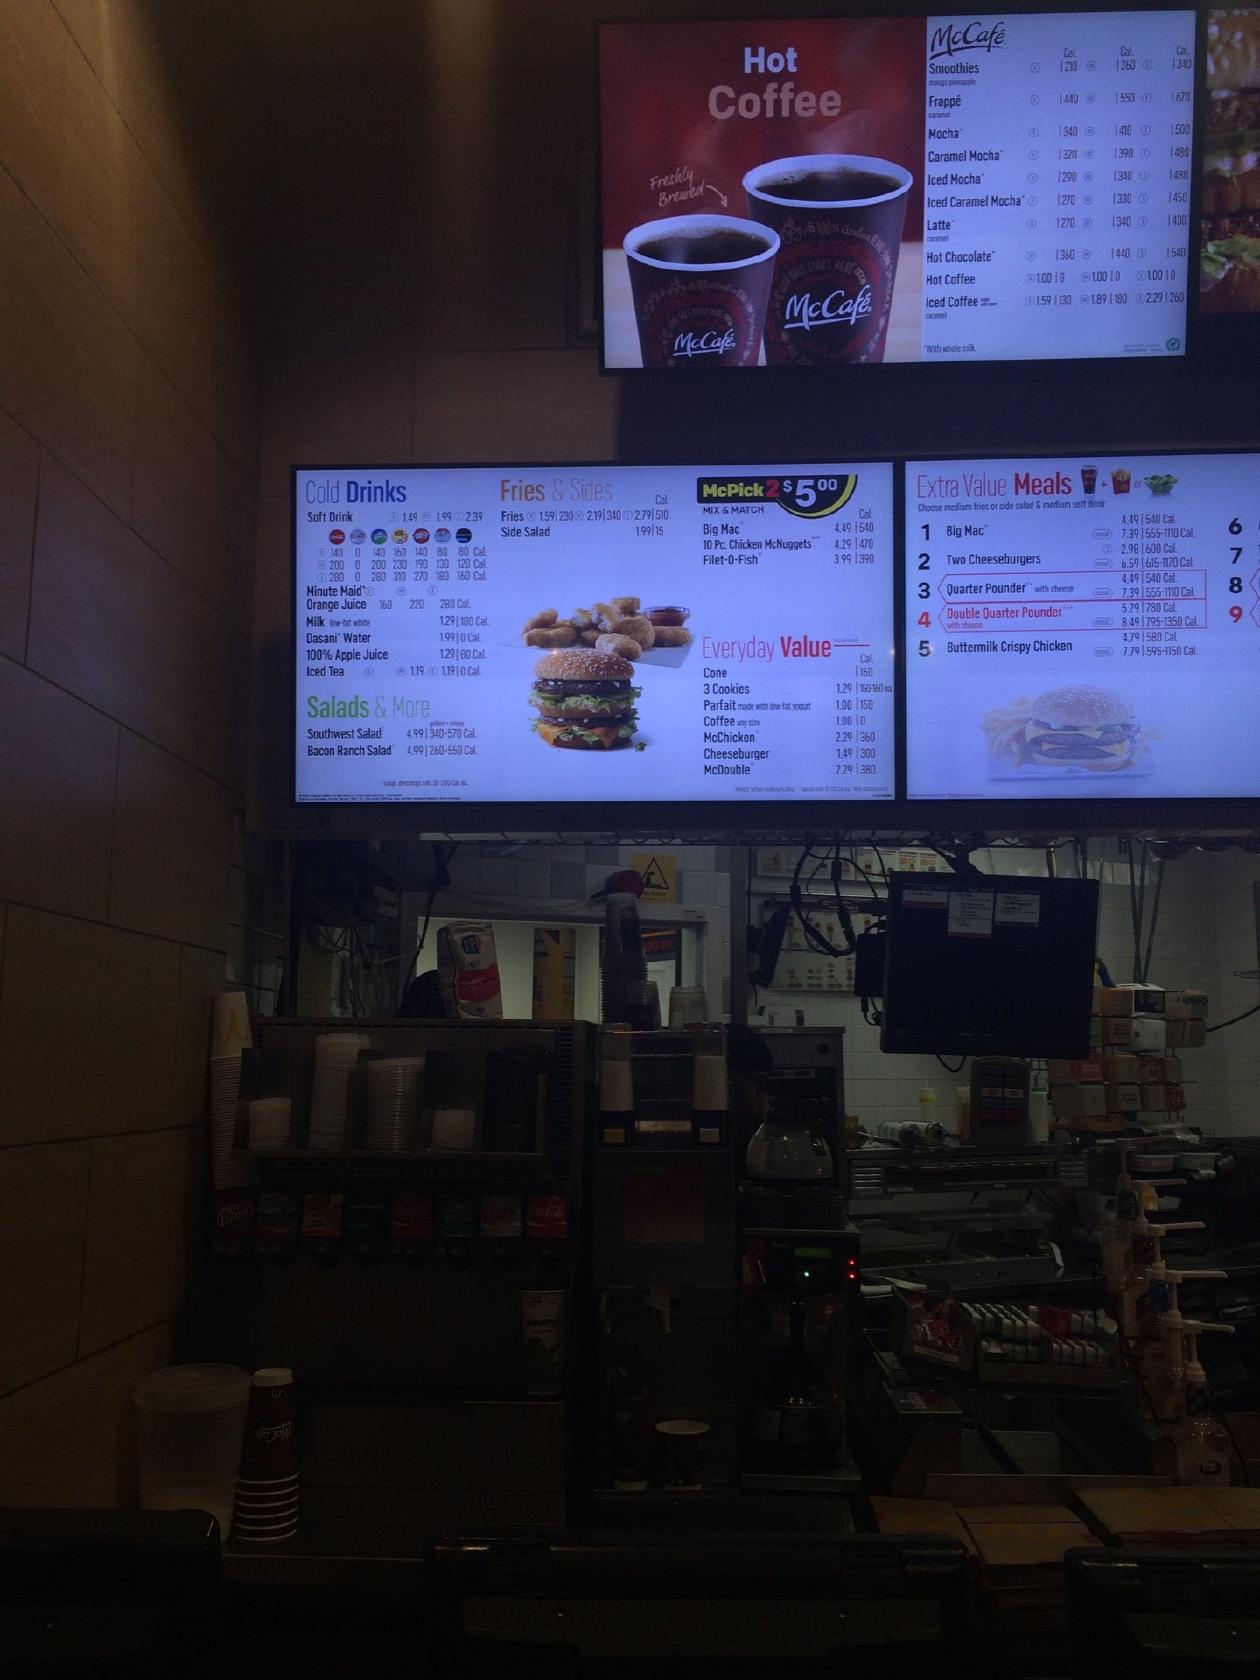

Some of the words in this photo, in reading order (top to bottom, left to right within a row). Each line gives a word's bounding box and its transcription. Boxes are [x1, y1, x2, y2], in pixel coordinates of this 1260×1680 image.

[929, 21, 1005, 60] McCafé
[744, 47, 797, 73] Hot
[929, 62, 979, 75] Smoothies
[709, 82, 842, 120] Coffee
[929, 94, 961, 108] Frappé
[928, 151, 967, 163] Caramel
[650, 167, 693, 191] Freshly
[928, 174, 948, 186] Iced
[658, 180, 705, 206] Brewed
[928, 196, 948, 208] Iced
[950, 195, 989, 207] Caramel
[927, 252, 943, 263] Hot
[927, 274, 942, 285] Hot
[944, 274, 976, 284] Coffee
[784, 284, 872, 330] McCafé
[926, 297, 946, 308] Iced
[948, 296, 978, 307] Coffee
[673, 329, 736, 356] McCafé
[501, 480, 545, 501] Fries
[571, 479, 612, 500] Sides
[703, 483, 764, 497] McPick
[766, 480, 779, 497] 2
[918, 474, 958, 498] Extra
[964, 473, 1006, 496] Value
[1015, 472, 1072, 496] Meals
[306, 480, 340, 503] Cold
[347, 480, 406, 503] Drinks
[918, 504, 942, 512] Choose
[945, 503, 971, 511] medium
[974, 503, 989, 511] fries
[1000, 502, 1013, 510] side
[1015, 502, 1033, 510] salad
[1043, 501, 1071, 509] medium
[308, 512, 326, 522] Soft
[329, 512, 352, 522] Drink
[403, 513, 418, 521] 1.49
[437, 513, 452, 521] 1.99
[466, 512, 483, 521] 2.39
[501, 512, 524, 521] Fries
[1122, 515, 1138, 524] 4.49
[501, 527, 521, 537] Side
[525, 527, 550, 537] Salad
[703, 524, 718, 535] Big
[721, 524, 740, 534] Mac
[835, 523, 851, 532] 4.49
[922, 524, 930, 540] 1
[947, 526, 961, 538] Big
[965, 525, 984, 536] Mac
[1229, 518, 1242, 535] 6
[1122, 529, 1138, 539] 7.39
[1146, 528, 1179, 538] 555-1110
[703, 541, 712, 549] 10
[715, 540, 727, 549] Pc.
[729, 540, 762, 549] Chicken
[765, 539, 812, 550] McNuggets
[835, 539, 851, 548] 4.29
[1122, 545, 1138, 554] 2.98
[703, 555, 758, 565] Filet-O-Fish
[834, 555, 851, 564] 3.99
[918, 553, 930, 570] 2
[947, 555, 966, 565] Two
[969, 554, 1041, 566] Cheeseburgers
[1230, 547, 1242, 564] 7
[1122, 559, 1138, 568] 6.59
[1122, 574, 1139, 583] 4.49
[919, 583, 930, 599] 3
[947, 583, 982, 595] Quarter
[986, 583, 1025, 593] Pounder
[1229, 577, 1242, 593] 8
[307, 586, 338, 597] Minute
[340, 586, 362, 596] Maid
[1122, 588, 1139, 598] 7.39
[1147, 587, 1179, 597] 555-1110
[307, 600, 339, 612] Orange
[342, 599, 366, 609] Juice
[1122, 603, 1139, 613] 5.29
[918, 612, 931, 628] 4
[947, 608, 980, 619] Double
[983, 607, 1019, 619] Quarter
[1022, 606, 1062, 617] Pounder
[1230, 606, 1242, 623] 9
[307, 617, 325, 627] Milk
[1122, 617, 1139, 627] 8.49
[1147, 616, 1182, 626] 795-1350
[307, 633, 337, 643] Dasani
[344, 633, 371, 643] Water
[1123, 632, 1139, 642] 4.79
[703, 636, 774, 662] Everyday
[781, 635, 831, 657] Value
[919, 641, 931, 657] 5
[947, 641, 998, 653] Buttermilk
[1001, 641, 1030, 654] Crispy
[1034, 640, 1072, 651] Chicken
[1123, 647, 1139, 656] 7.79
[307, 650, 332, 660] 100%
[335, 649, 361, 661] Apple
[363, 650, 388, 660] Juice
[307, 667, 326, 676] Iced
[329, 667, 344, 676] Tea
[704, 668, 727, 678] Cone
[713, 683, 749, 694] Cookies
[837, 683, 852, 693] 1.29
[308, 696, 369, 718] Salads
[393, 696, 430, 718] More
[704, 700, 736, 710] Parfait
[793, 703, 811, 712] yogurt
[836, 700, 852, 709] 1.00
[704, 716, 735, 726] Coffee
[836, 716, 852, 725] 1.00
[308, 728, 354, 739] Southwest
[357, 728, 381, 739] Salad
[407, 729, 423, 738] 4.99
[704, 732, 755, 742] McChicken
[836, 732, 852, 742] 2.29
[308, 746, 334, 756] Bacon
[337, 746, 364, 756] Ranch
[368, 745, 391, 756] Salad
[407, 746, 423, 755] 4.99
[704, 749, 769, 760] Cheeseburger
[704, 765, 750, 775] McDouble
[836, 765, 852, 774] 2.29
